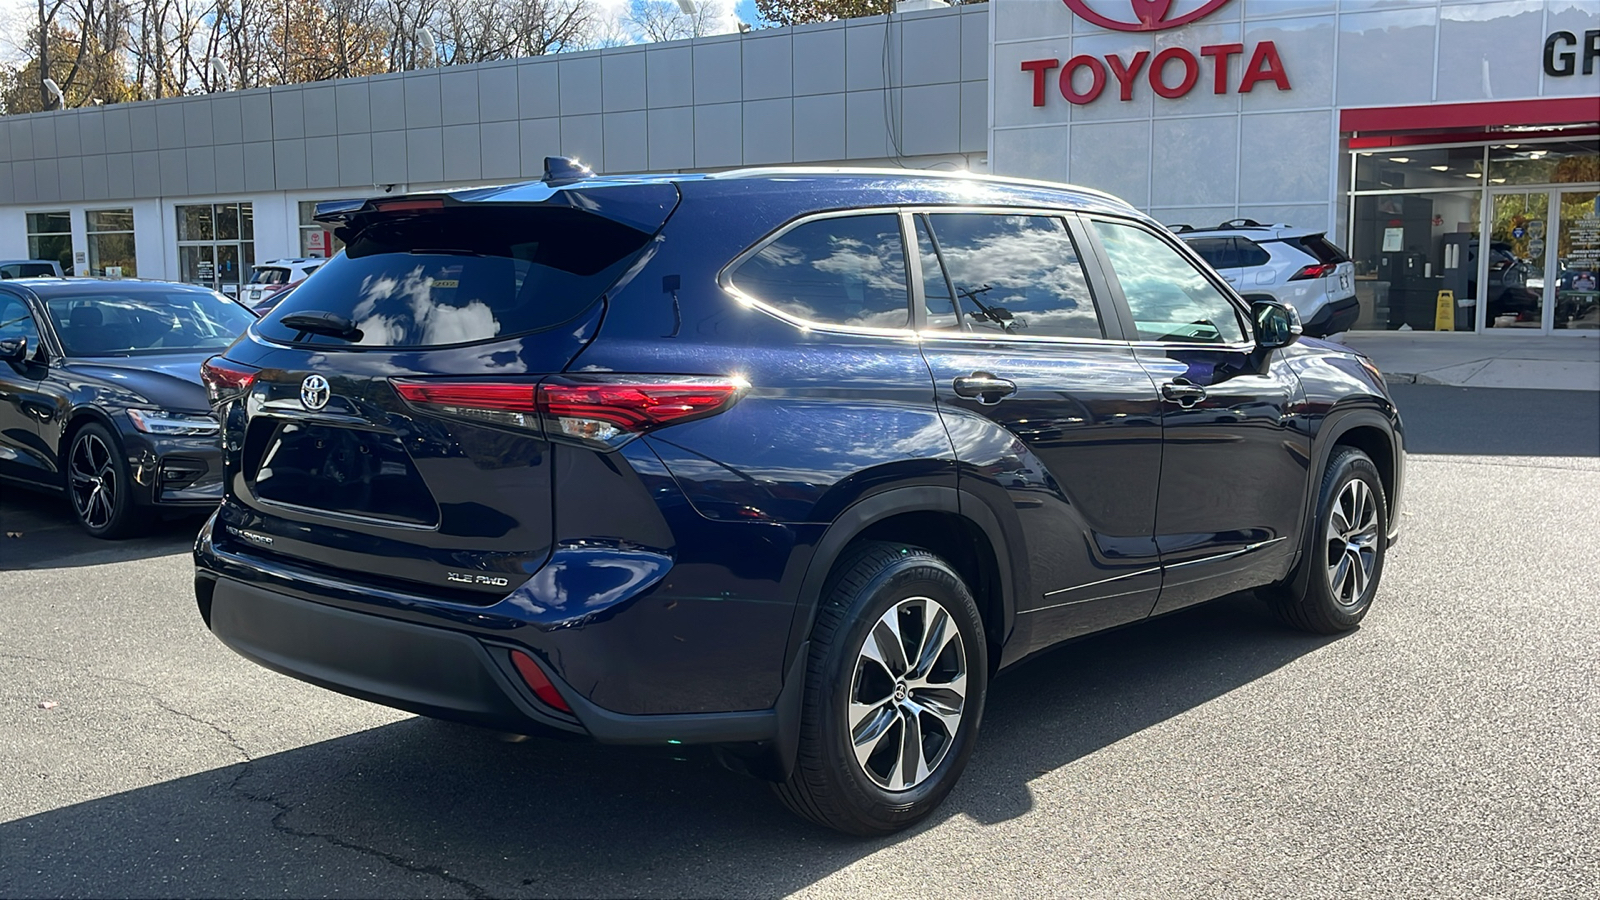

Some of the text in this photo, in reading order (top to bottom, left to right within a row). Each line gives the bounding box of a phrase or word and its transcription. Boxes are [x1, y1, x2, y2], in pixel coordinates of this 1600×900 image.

[1020, 40, 1292, 107] TOYOTA
[447, 571, 509, 586] XLE AWD
